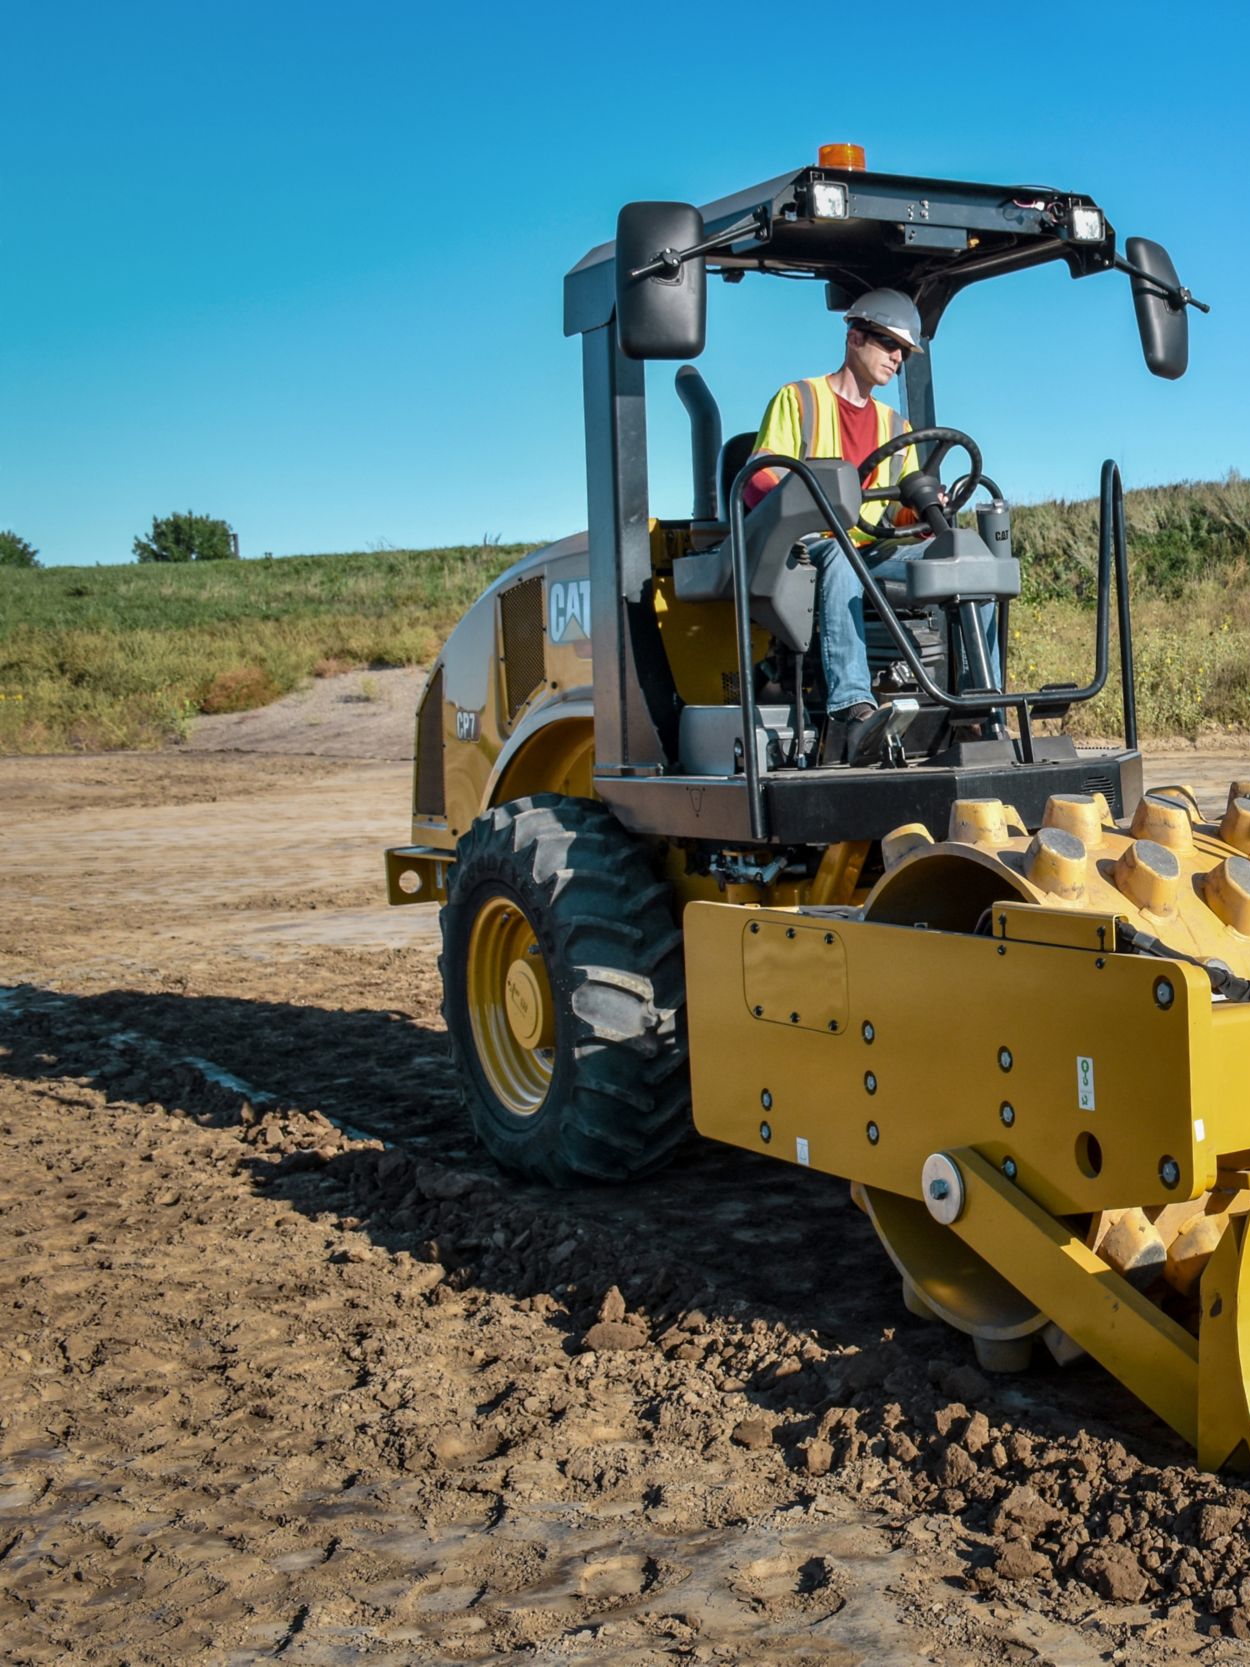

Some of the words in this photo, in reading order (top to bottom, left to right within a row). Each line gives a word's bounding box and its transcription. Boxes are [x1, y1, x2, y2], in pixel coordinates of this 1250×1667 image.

[995, 530, 1009, 541] CAT
[550, 580, 591, 642] CAT
[456, 711, 475, 739] CP7
